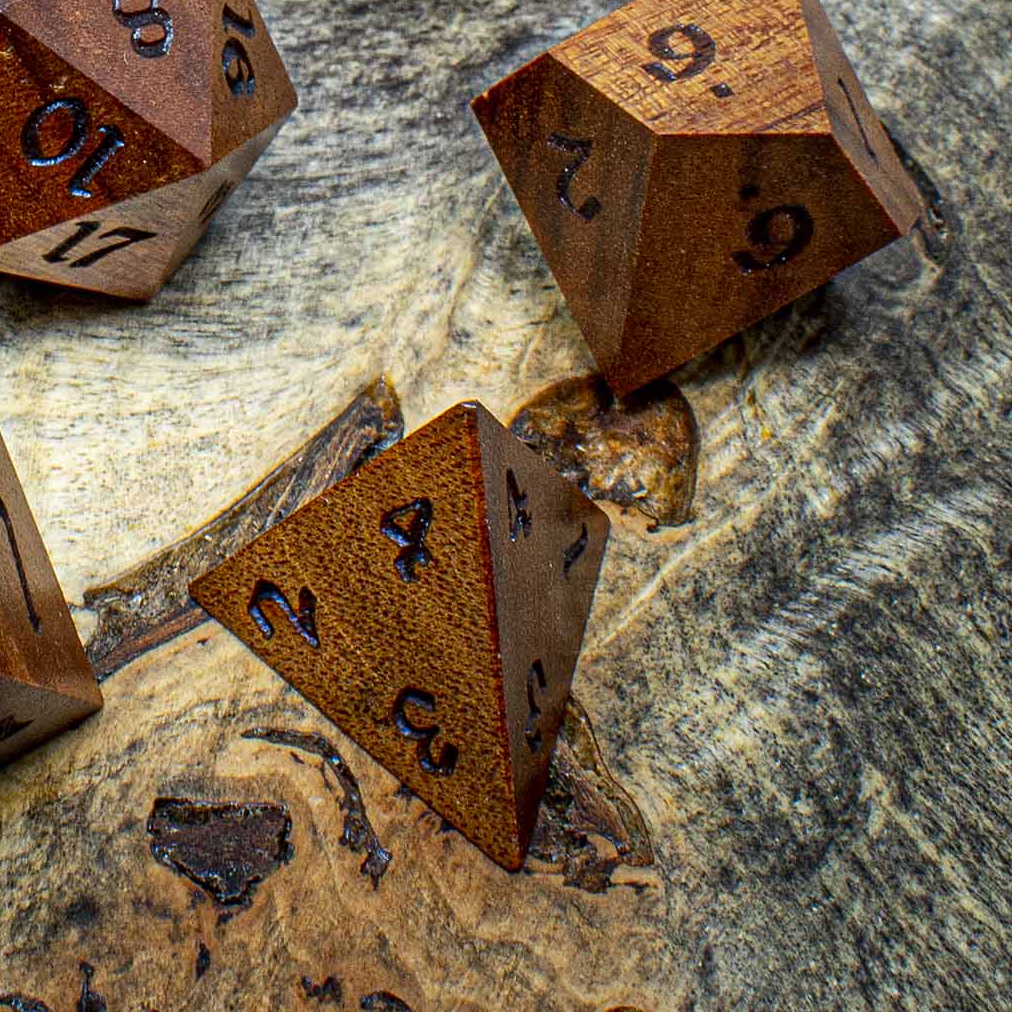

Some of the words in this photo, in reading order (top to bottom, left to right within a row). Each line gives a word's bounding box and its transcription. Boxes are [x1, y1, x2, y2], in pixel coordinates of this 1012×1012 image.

[20, 96, 125, 199] 10
[42, 220, 159, 269] 17
[380, 497, 434, 583] 4
[247, 578, 320, 649] 2
[393, 687, 459, 776] 3
